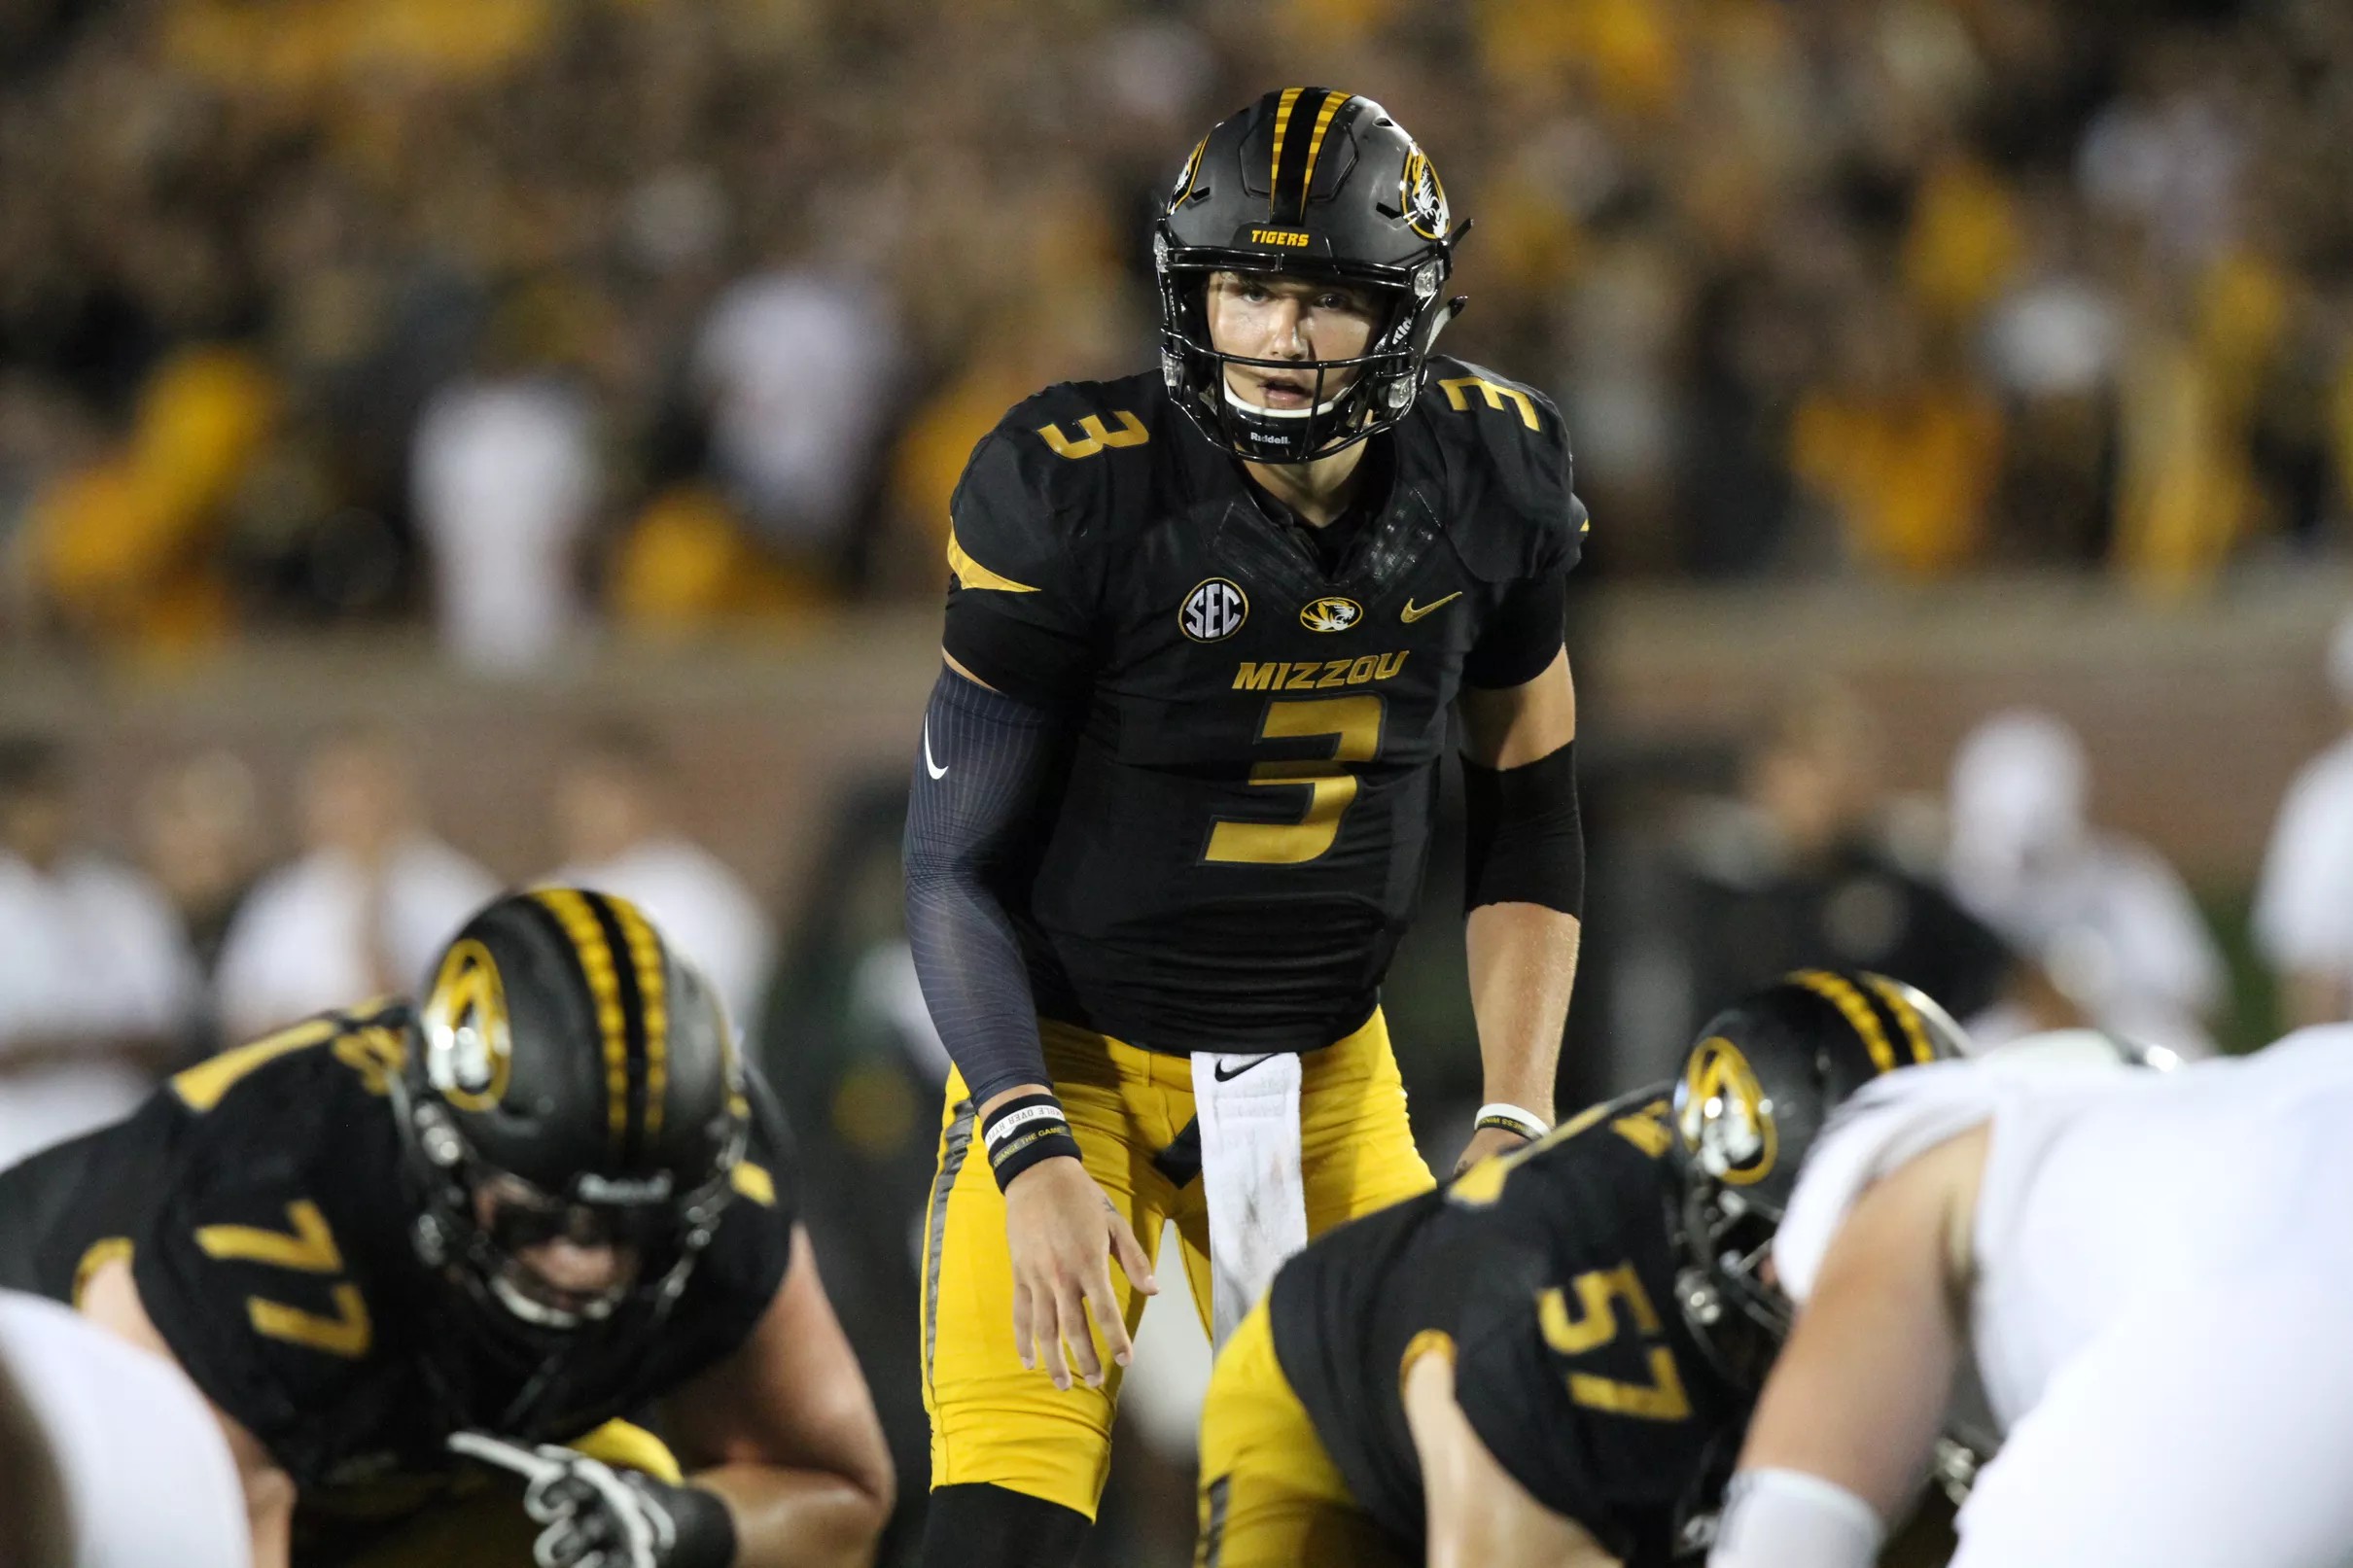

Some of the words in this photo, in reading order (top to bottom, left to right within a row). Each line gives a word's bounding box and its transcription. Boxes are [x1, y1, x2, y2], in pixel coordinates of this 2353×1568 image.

[1250, 229, 1309, 247] TIGERS
[1437, 376, 1541, 432] 3
[1036, 410, 1149, 460] 3
[1185, 583, 1242, 638] SEC
[1232, 650, 1409, 690] MIZZOU
[1203, 693, 1385, 864] 3
[1008, 1110, 1034, 1125] OVER
[1020, 1132, 1037, 1145] THE
[195, 1200, 371, 1357] 77
[1535, 1263, 1693, 1421] 57
